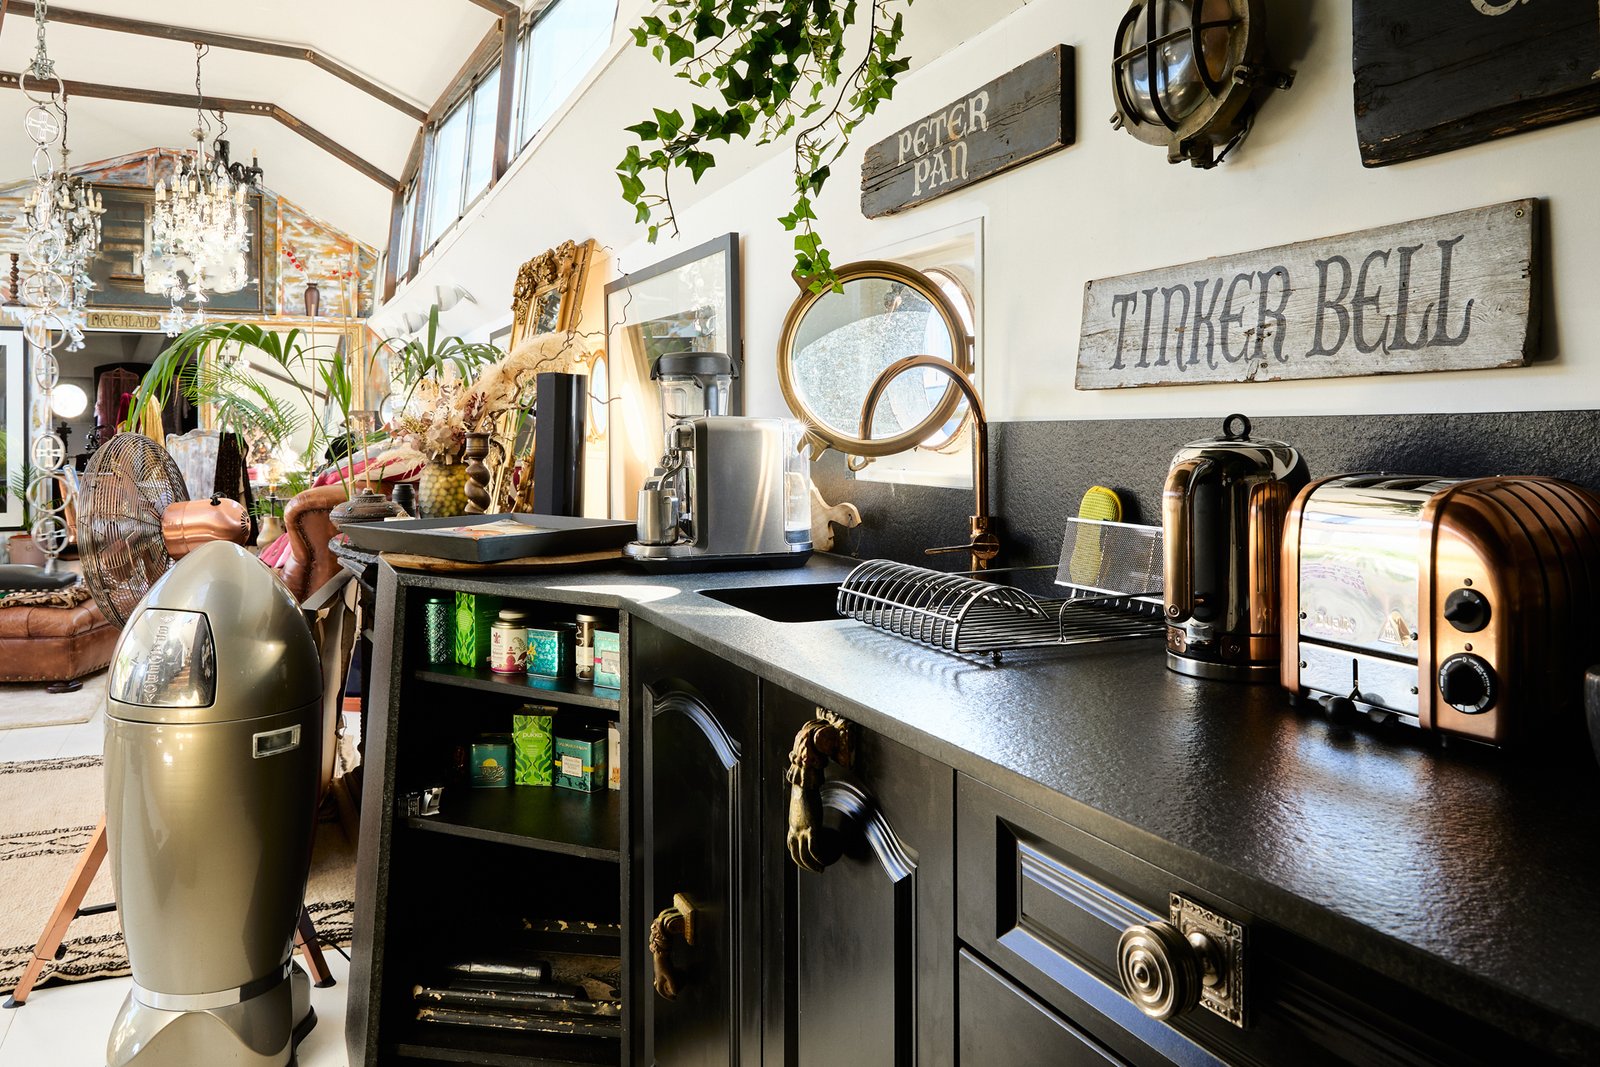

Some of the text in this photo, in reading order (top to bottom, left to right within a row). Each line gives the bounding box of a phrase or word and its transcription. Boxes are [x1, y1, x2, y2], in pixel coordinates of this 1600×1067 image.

[897, 90, 990, 166] PETER
[912, 141, 969, 197] PAN
[91, 313, 158, 328] NEVERLAND
[1109, 234, 1474, 372] TINKER BELL
